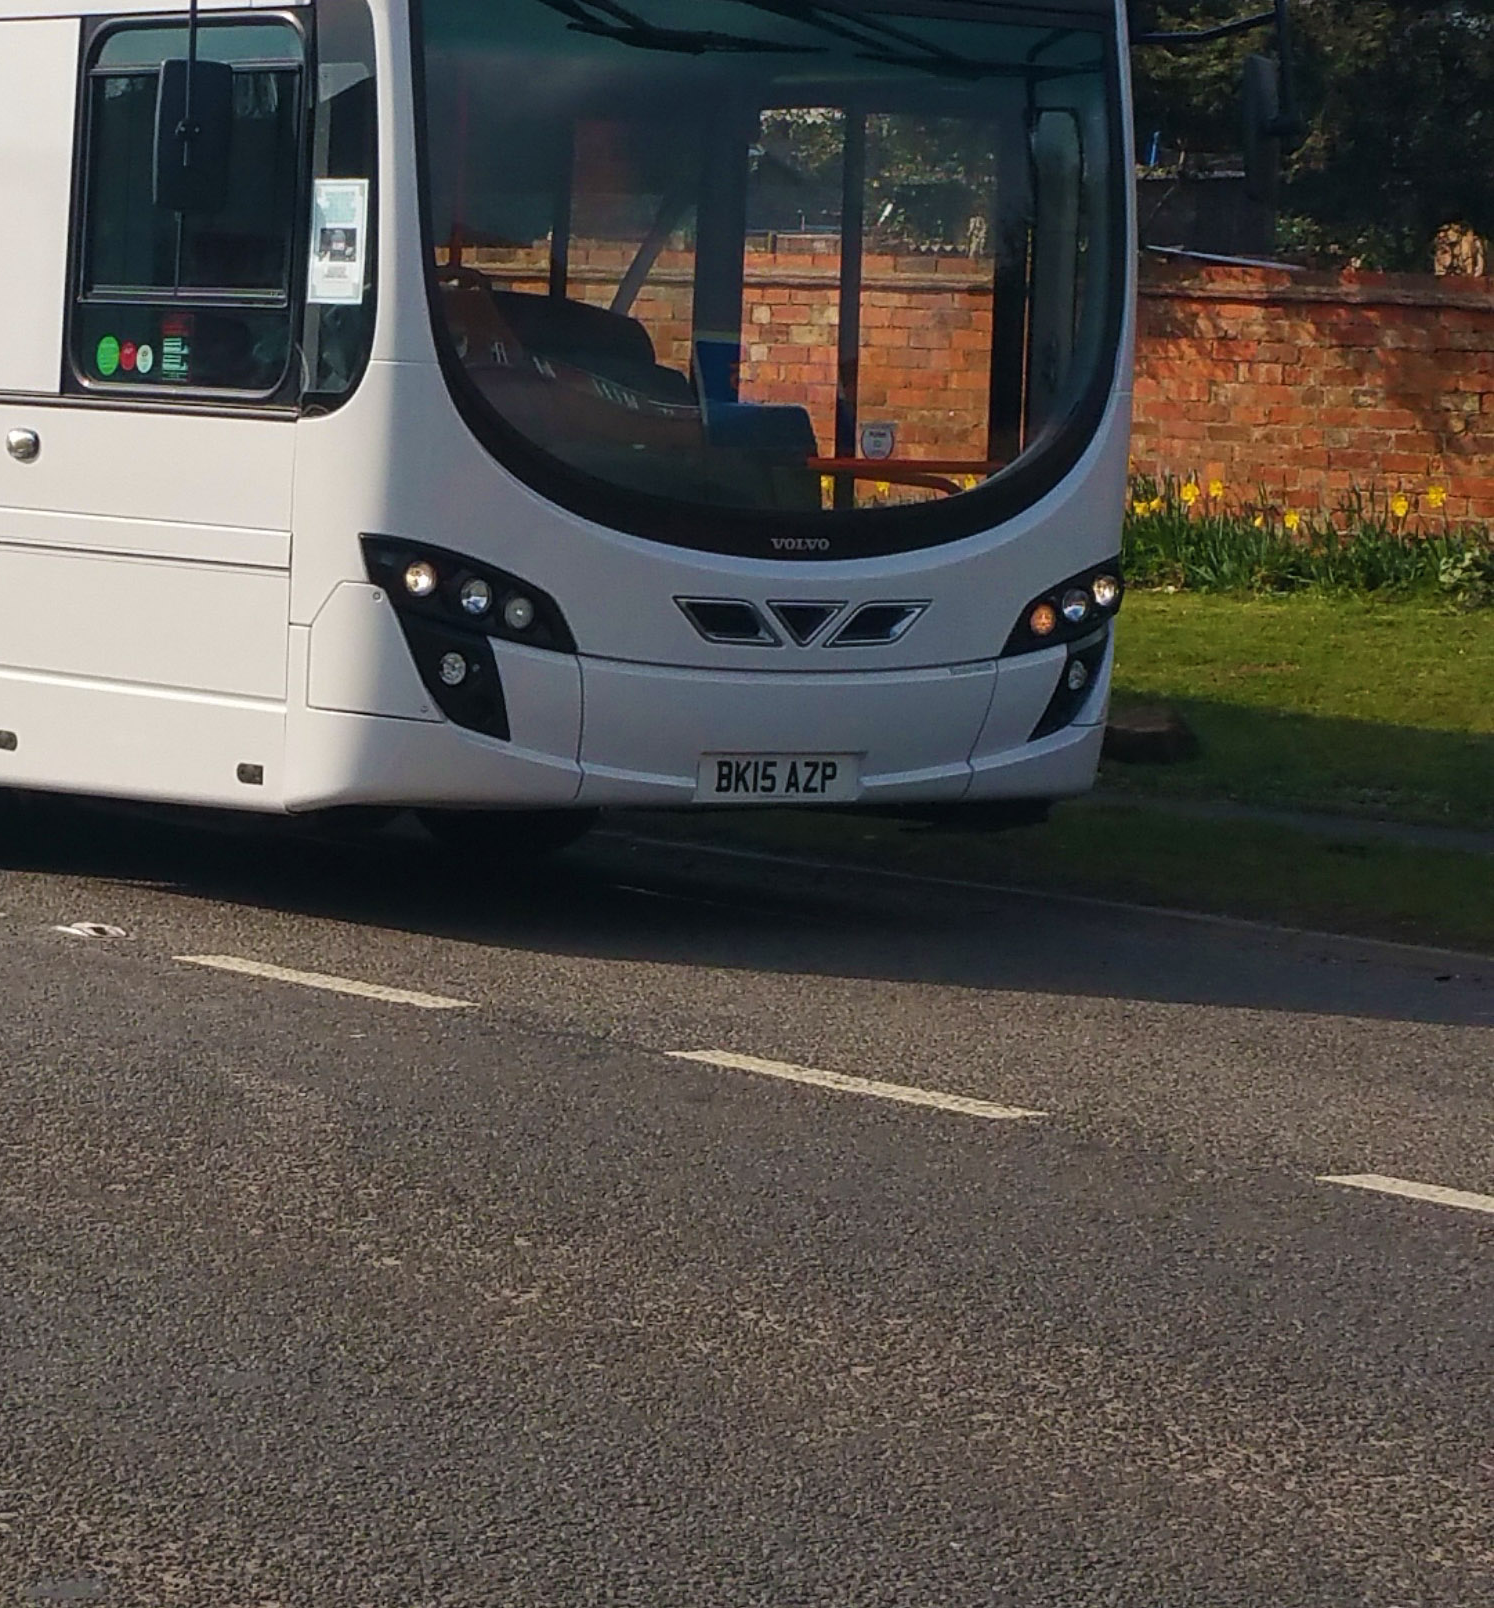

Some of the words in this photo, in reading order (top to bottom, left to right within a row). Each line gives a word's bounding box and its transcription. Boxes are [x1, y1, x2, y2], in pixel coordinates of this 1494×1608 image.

[770, 538, 831, 551] VOLVO
[715, 760, 778, 793] BK15
[784, 760, 838, 793] AZP
